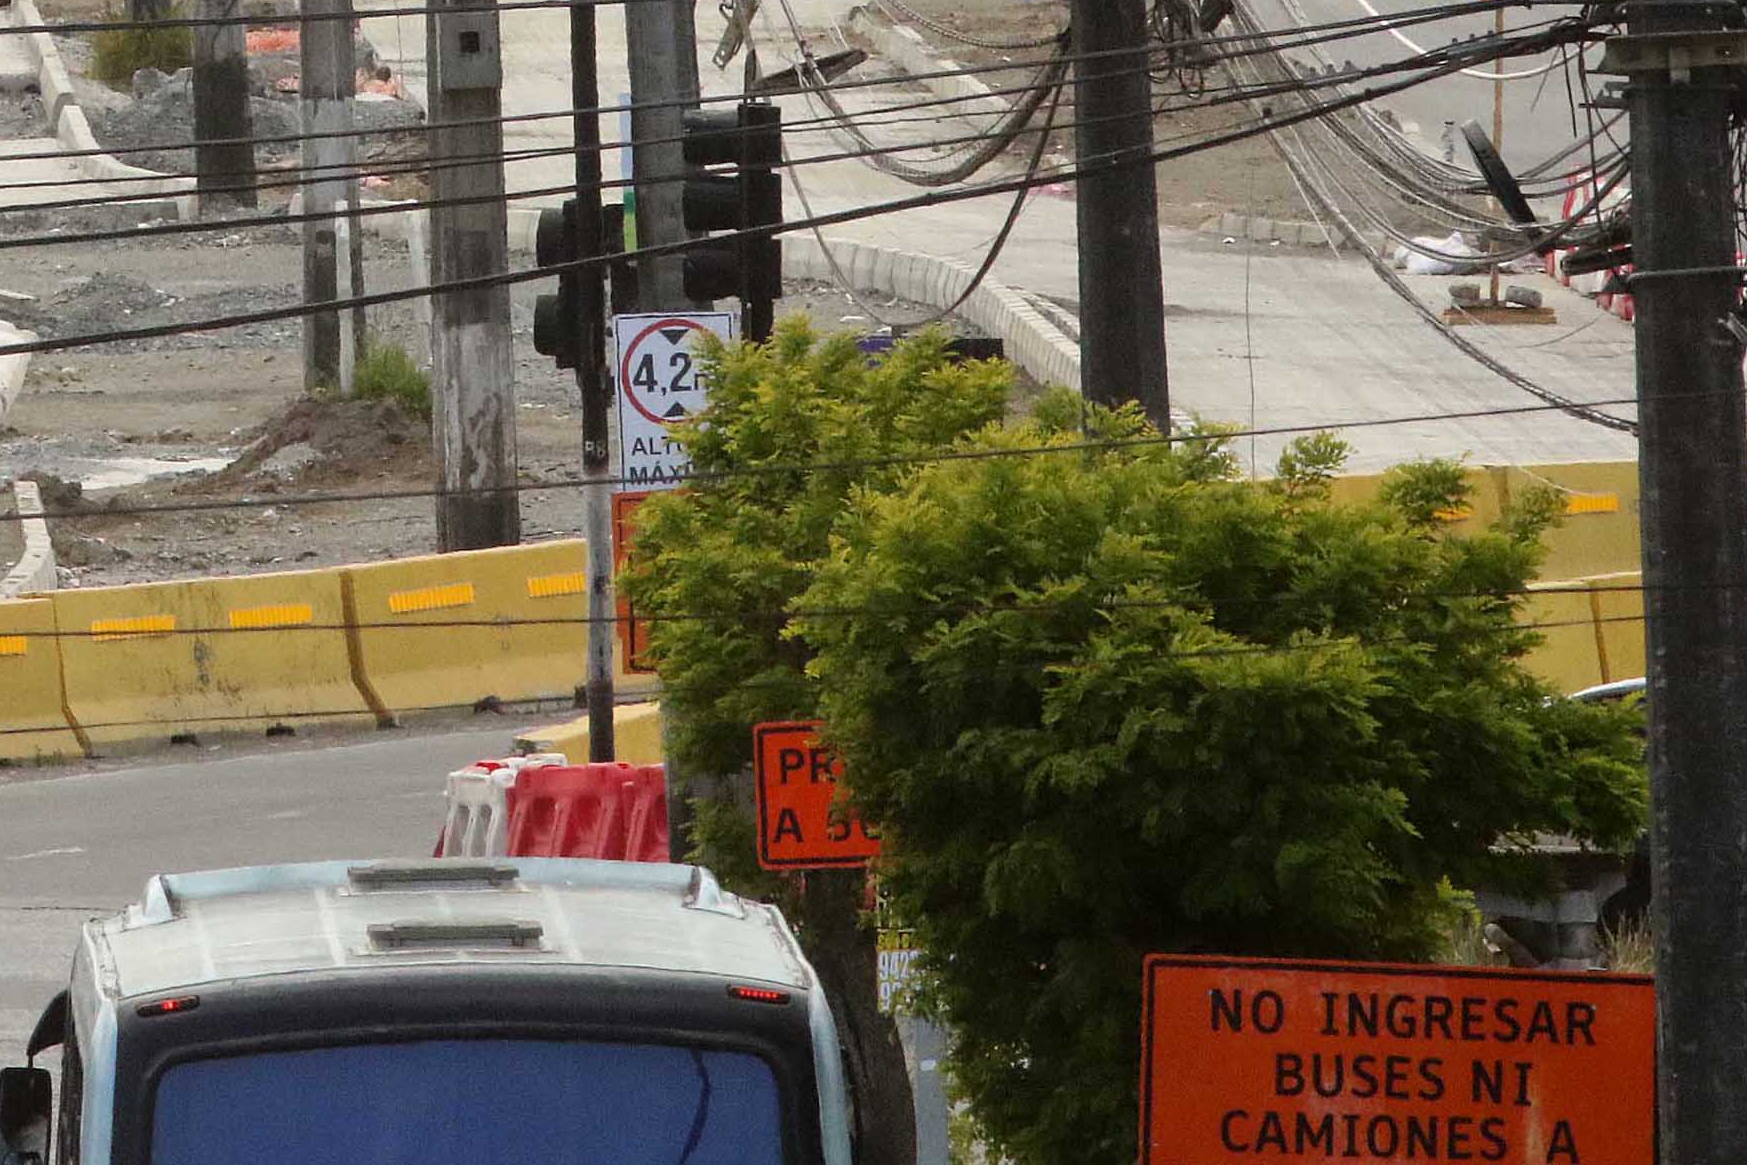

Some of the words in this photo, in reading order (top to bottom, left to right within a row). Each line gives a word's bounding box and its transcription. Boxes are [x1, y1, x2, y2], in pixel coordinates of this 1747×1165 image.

[773, 807, 804, 843] A
[1209, 988, 1285, 1035] NO
[1321, 992, 1597, 1046] INGRESAR
[1274, 1052, 1445, 1101] BUSES
[1471, 1059, 1532, 1107] NI
[1220, 1109, 1508, 1160] CAMIONES
[1546, 1119, 1579, 1165] A
